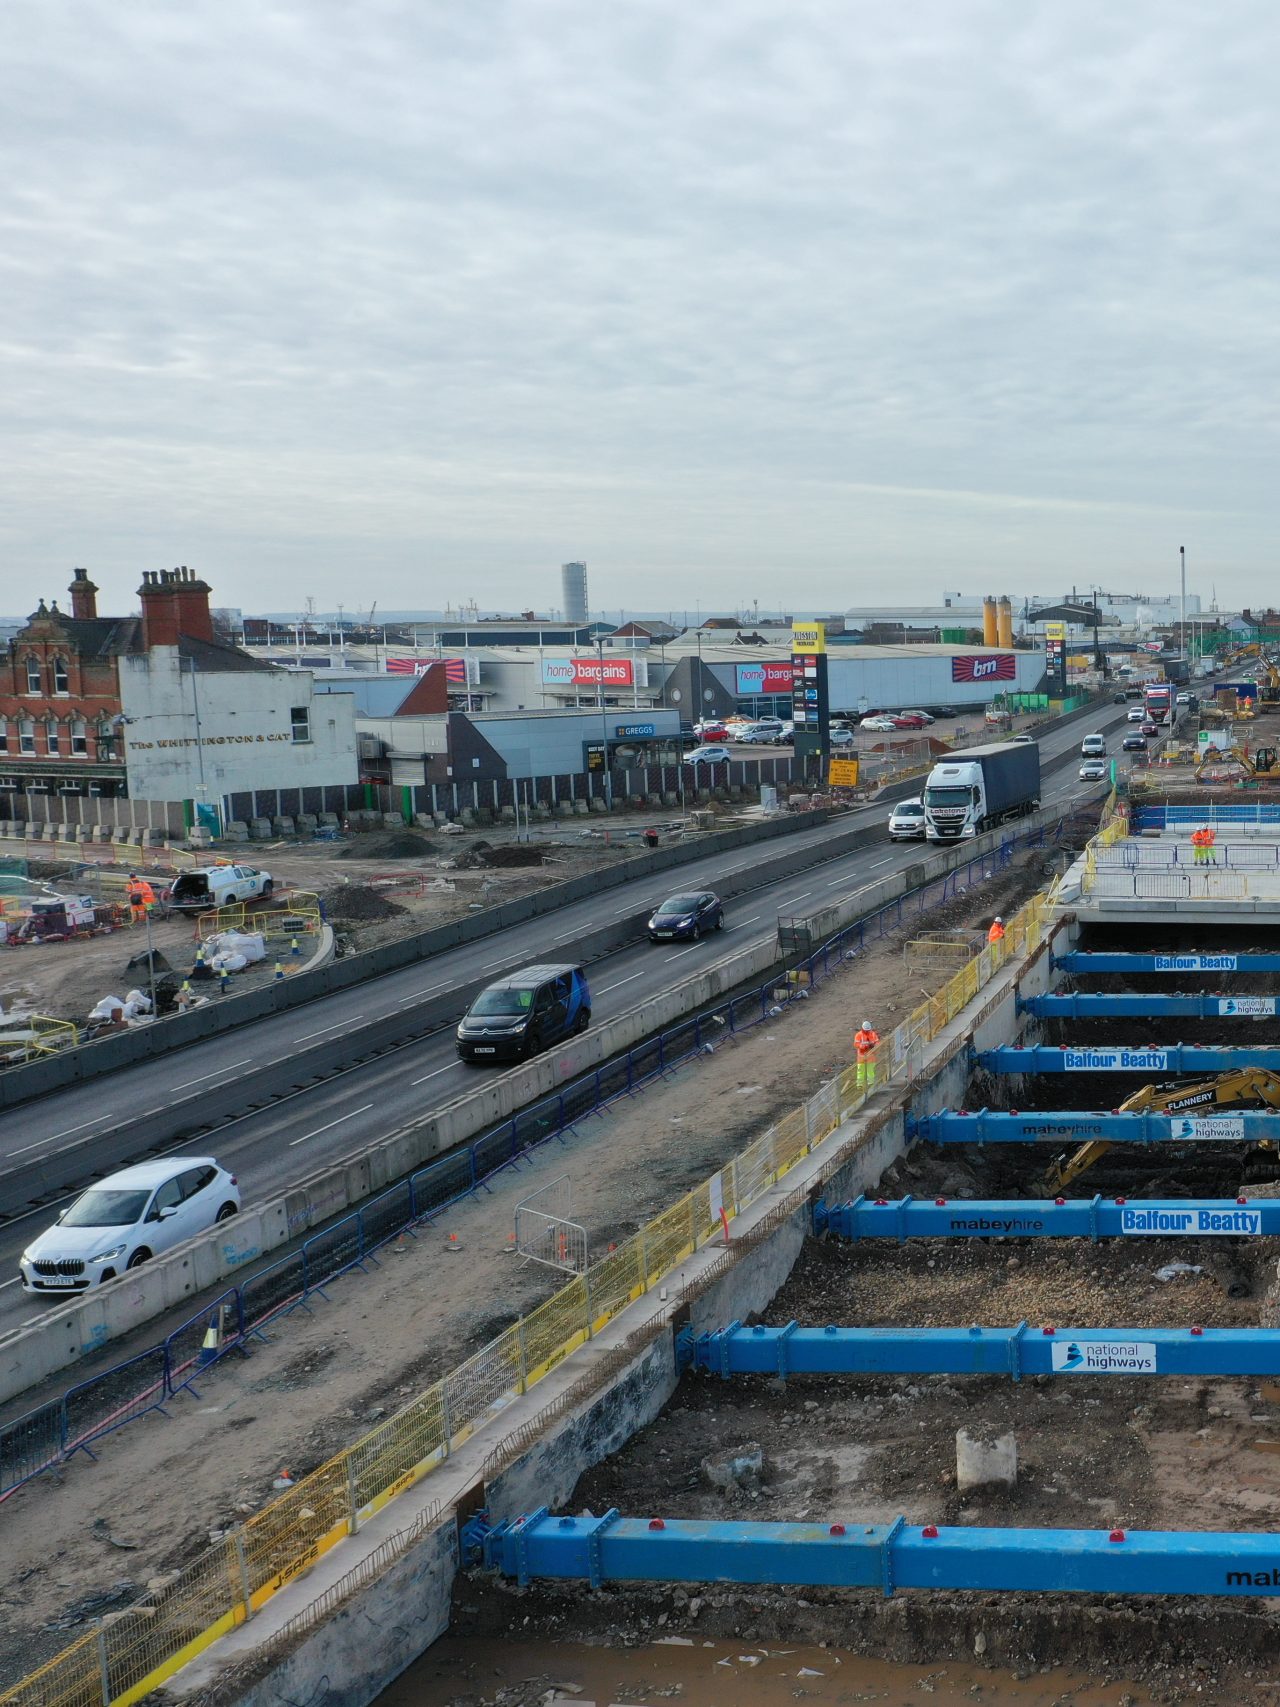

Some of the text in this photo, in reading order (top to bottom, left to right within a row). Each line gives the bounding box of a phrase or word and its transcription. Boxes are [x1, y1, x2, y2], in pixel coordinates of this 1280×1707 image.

[547, 663, 626, 682] home bargains
[741, 669, 765, 680] home
[767, 668, 793, 681] barg
[625, 726, 653, 735] GREGGS
[156, 735, 253, 748] WHITTINGTON
[266, 733, 290, 742] CAT
[1156, 956, 1236, 969] Balfour Beatty
[1237, 999, 1266, 1007] national
[1237, 1006, 1273, 1014] highways
[1065, 1052, 1166, 1069] Balfour Beatty
[1168, 1092, 1213, 1110] FLANNERY
[1196, 1121, 1234, 1129] national
[1196, 1128, 1241, 1138] highways
[951, 1218, 1043, 1233] mabeyhire
[1123, 1211, 1259, 1234] Balfour Beatty
[1086, 1344, 1138, 1355] national
[1087, 1356, 1152, 1370] highways
